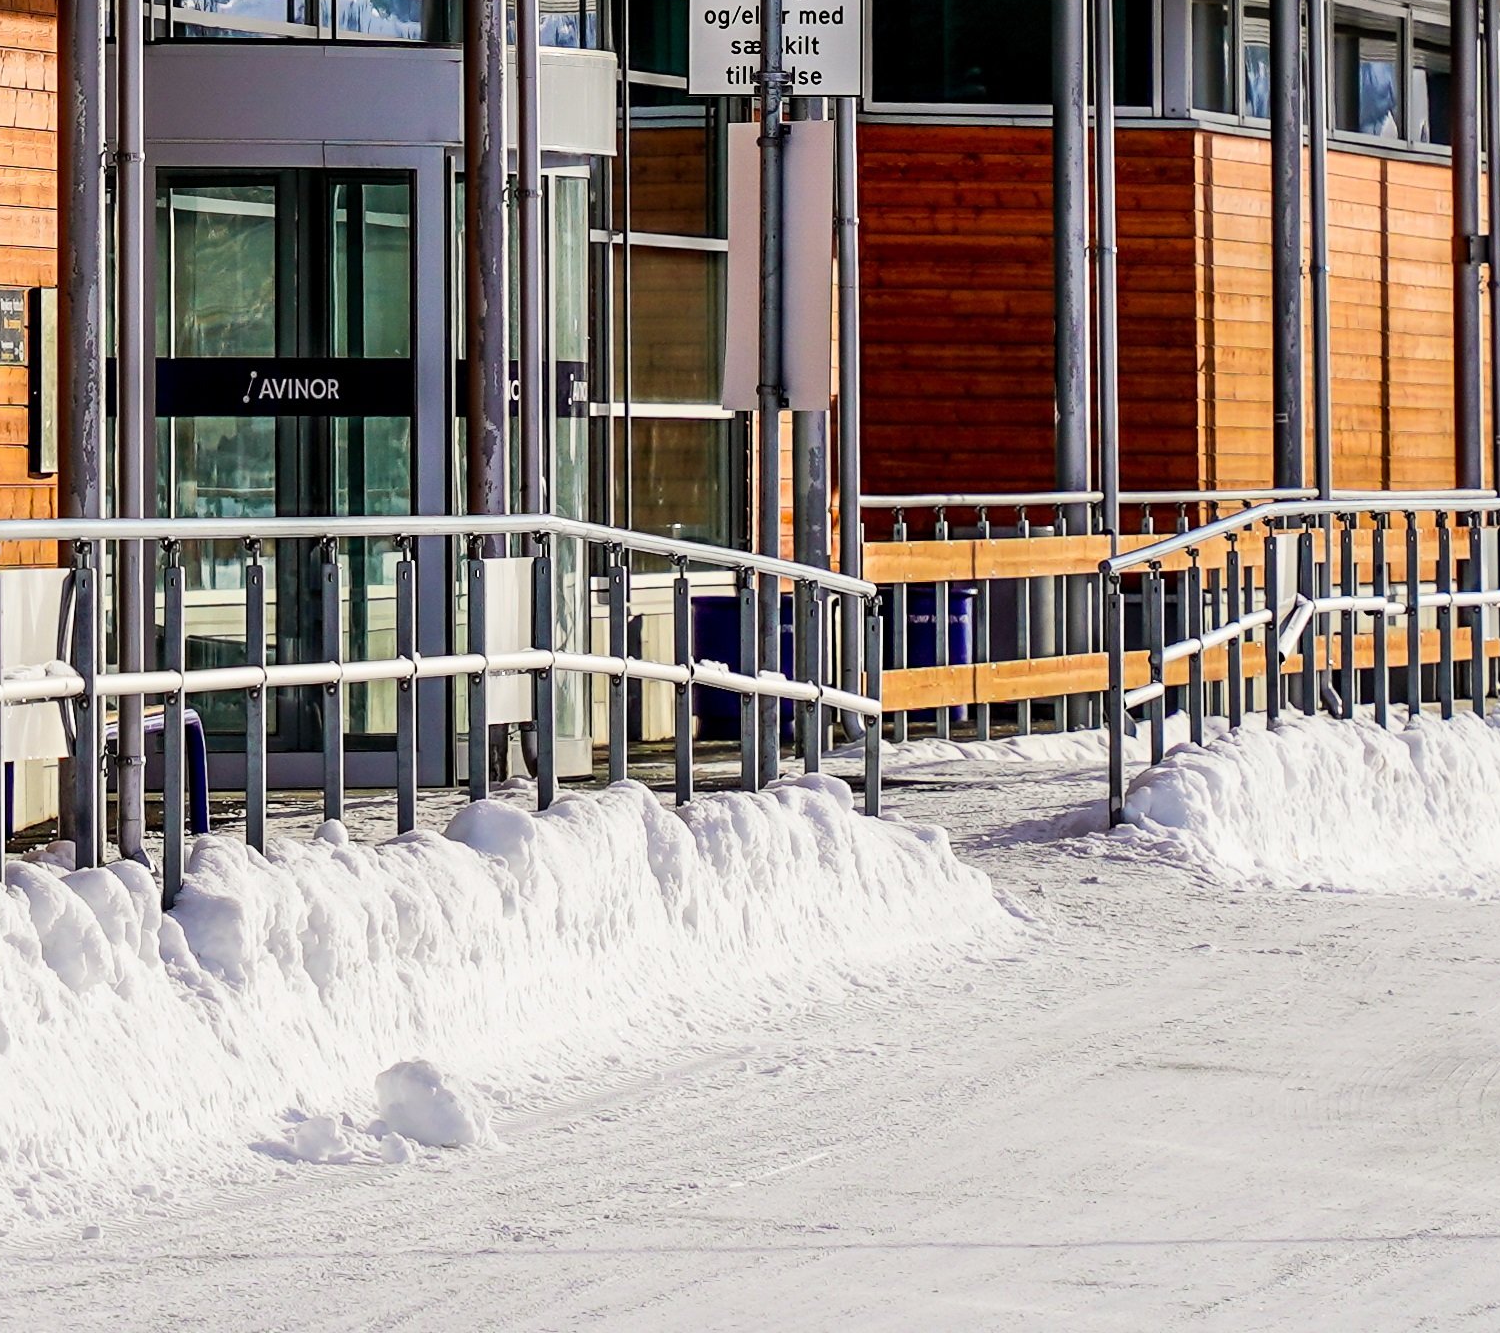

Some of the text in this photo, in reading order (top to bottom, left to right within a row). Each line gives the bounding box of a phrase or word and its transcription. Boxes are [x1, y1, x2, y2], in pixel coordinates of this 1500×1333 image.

[704, 5, 844, 29] og/elr med
[730, 35, 820, 55] sækilt
[258, 378, 340, 400] AVINOR
